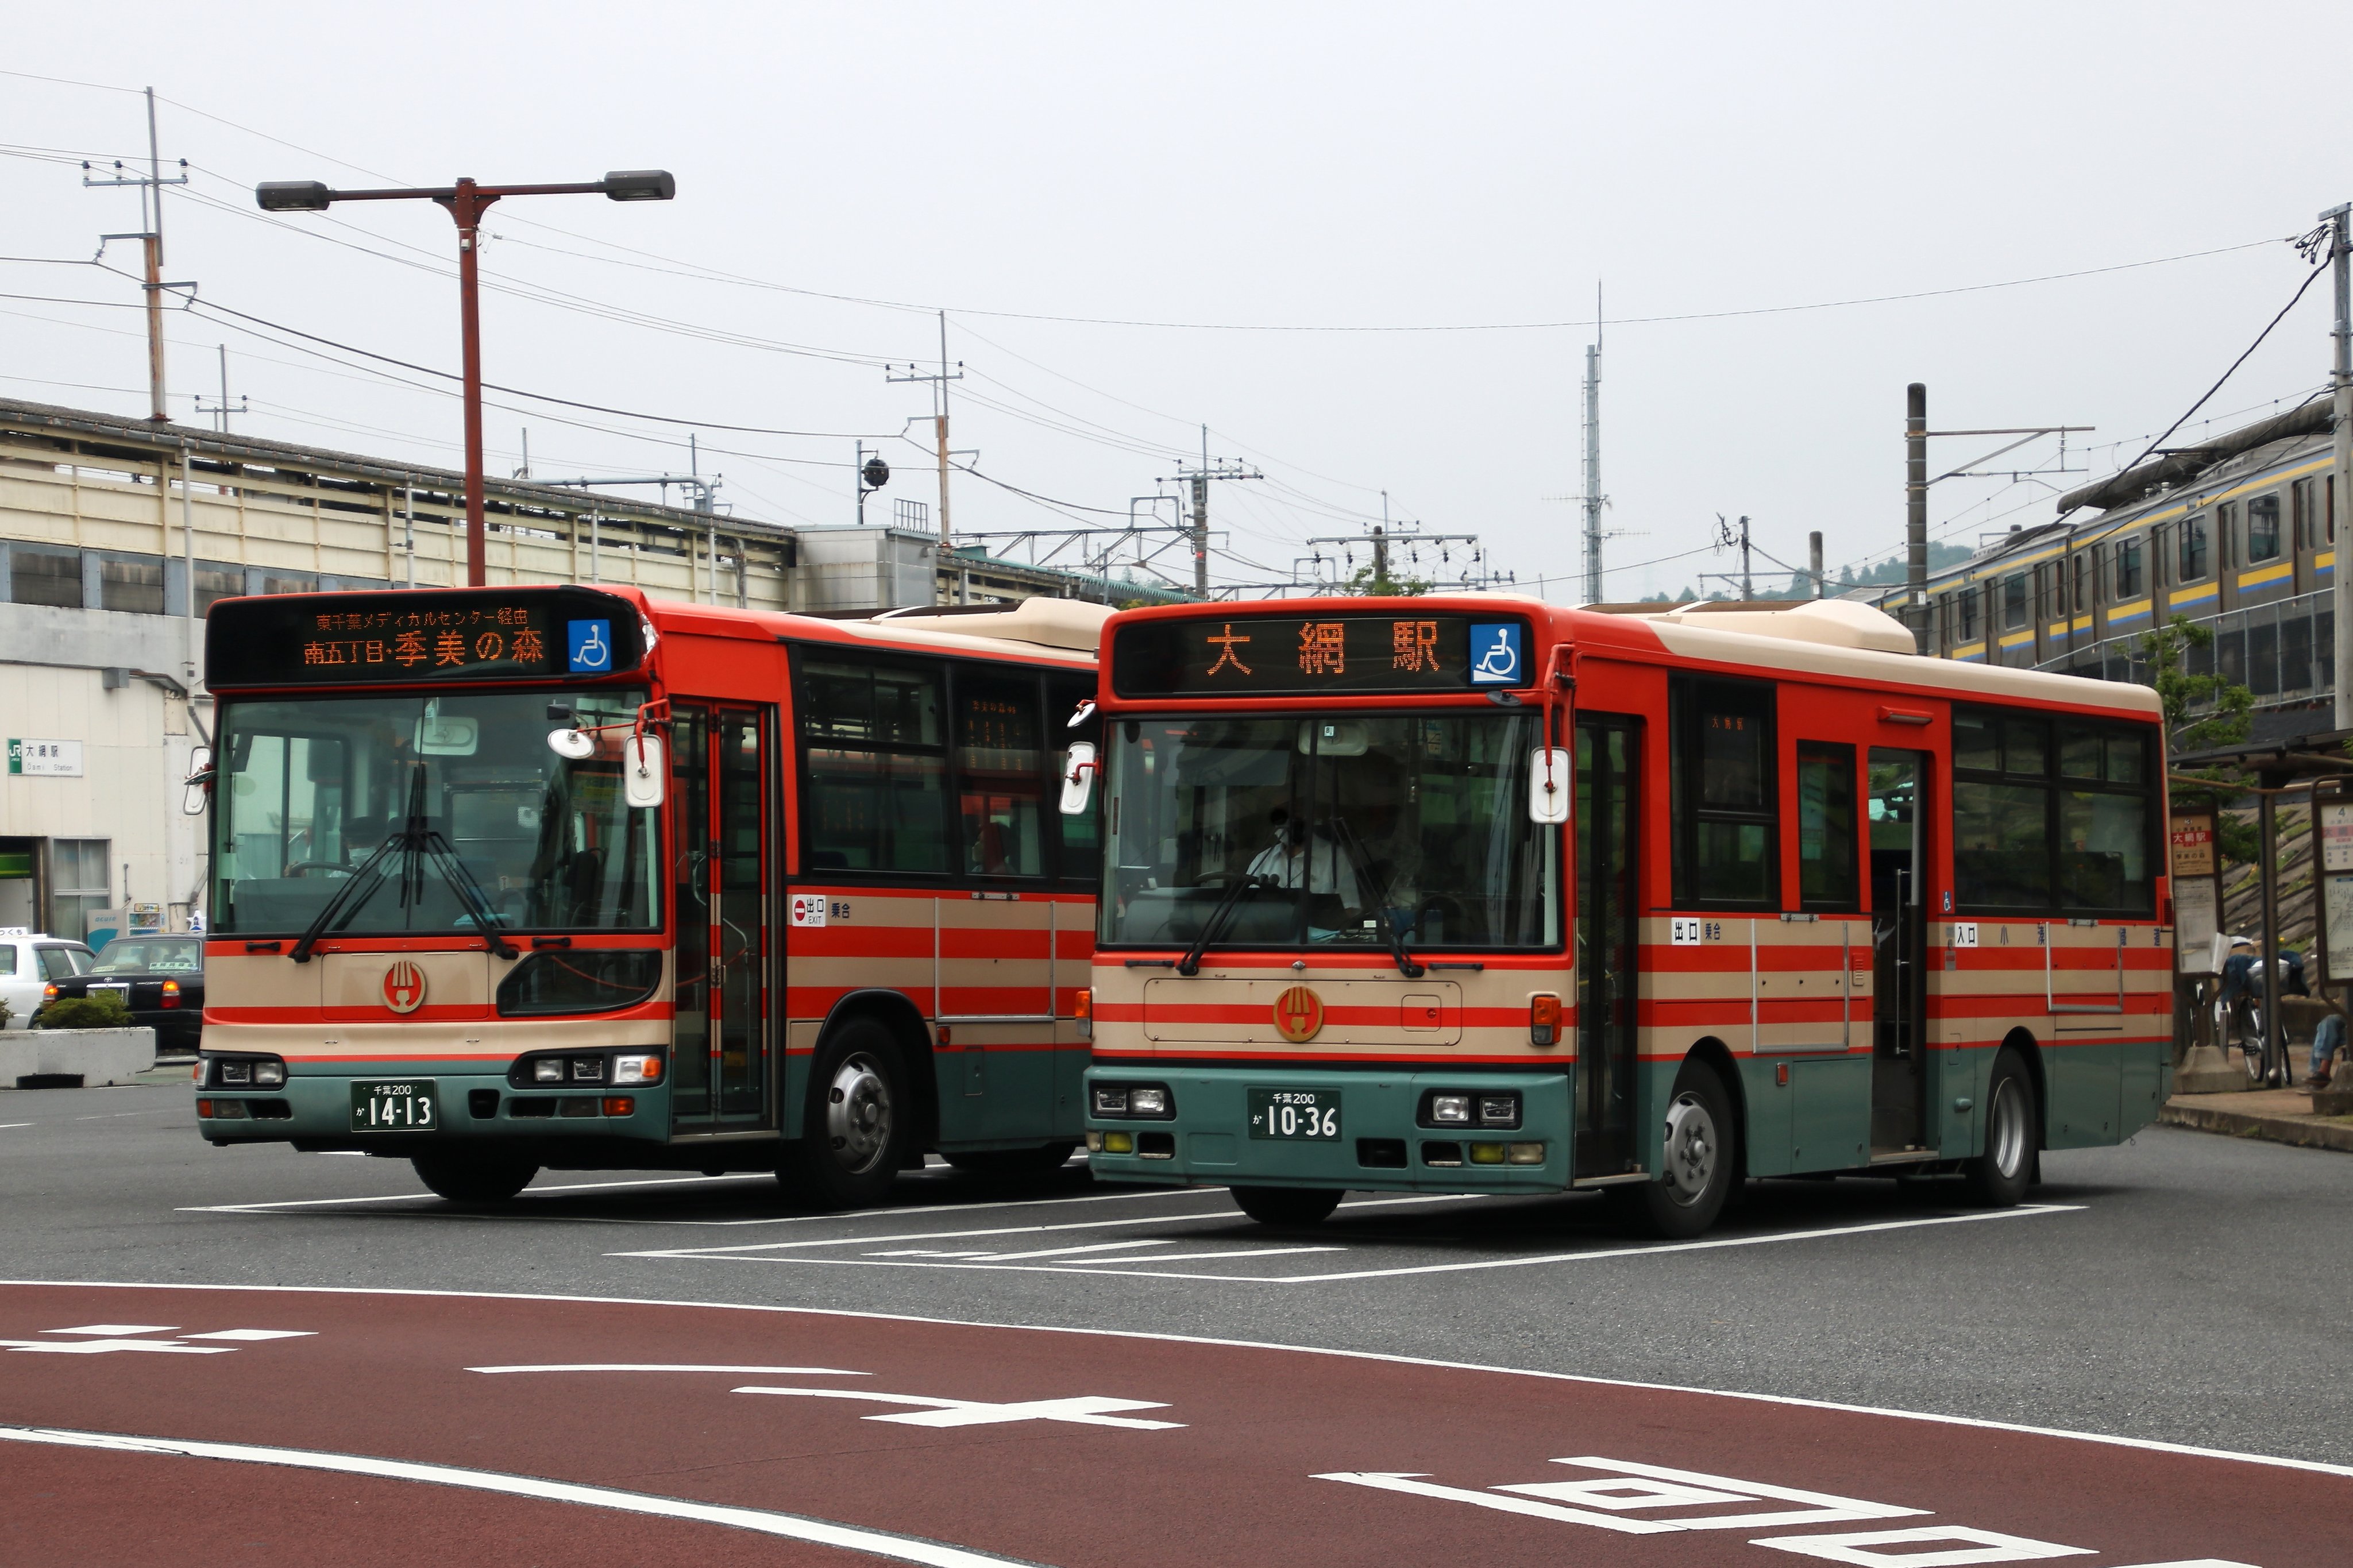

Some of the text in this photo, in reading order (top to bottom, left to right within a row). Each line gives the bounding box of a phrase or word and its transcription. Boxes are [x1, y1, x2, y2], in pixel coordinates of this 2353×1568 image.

[1206, 621, 1440, 675] 大網駅
[9, 745, 21, 756] JR
[2339, 807, 2345, 817] 4
[2173, 832, 2207, 843] 大網駅
[807, 898, 824, 913] 出口
[831, 902, 850, 919] 乗合
[808, 916, 821, 924] EXIT
[1675, 921, 1698, 942] 出口
[1705, 922, 1721, 940] 乗合
[1957, 925, 1976, 944] 入口
[356, 1096, 431, 1126] か 14-13
[1252, 1106, 1337, 1137] か 10-36
